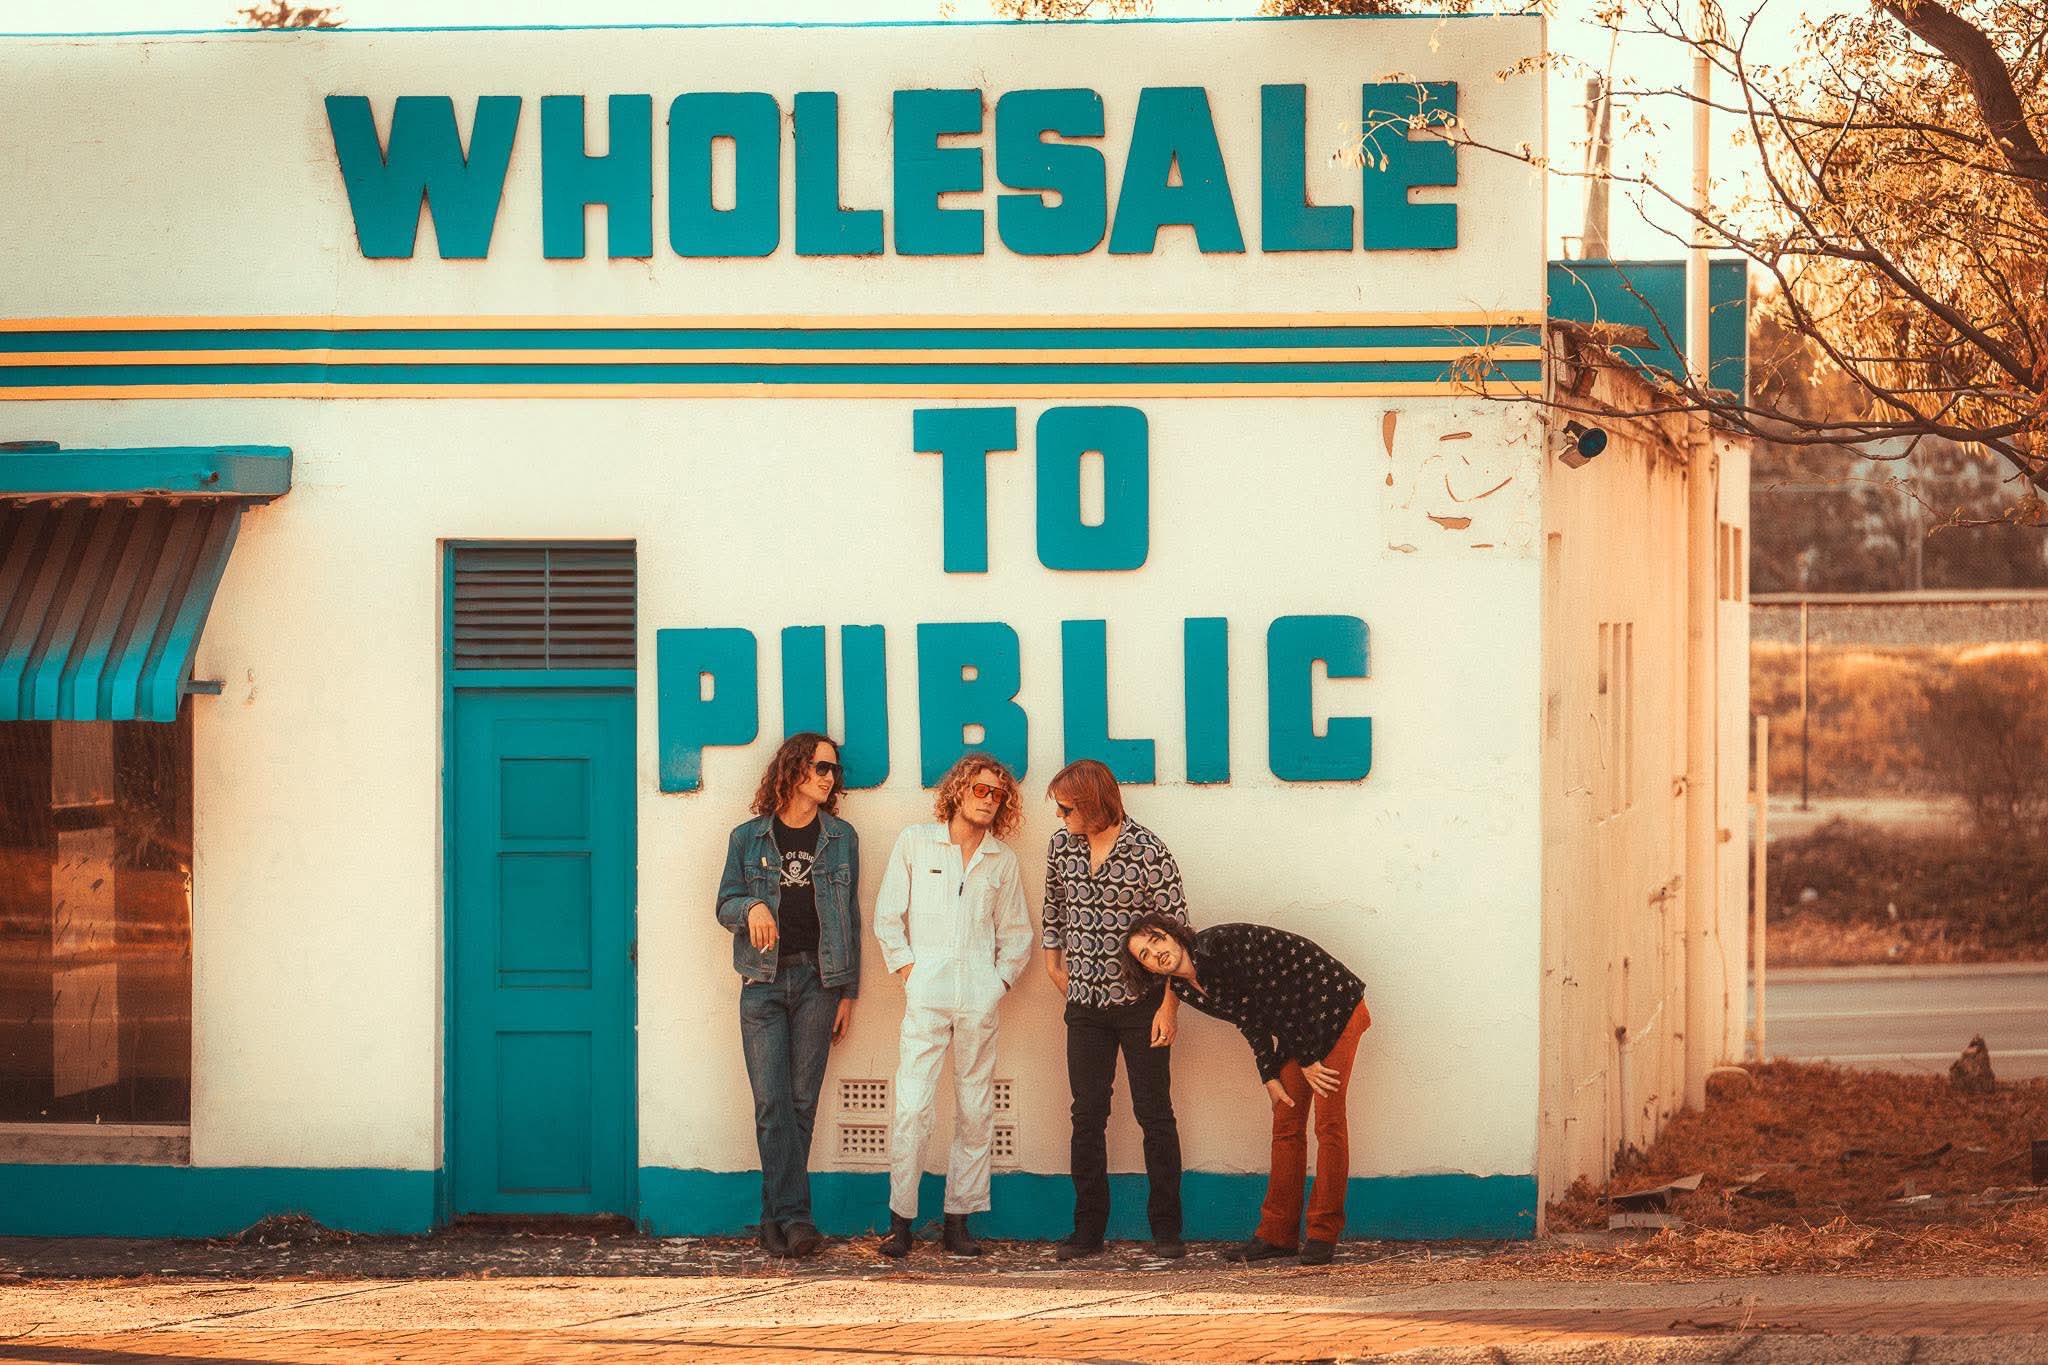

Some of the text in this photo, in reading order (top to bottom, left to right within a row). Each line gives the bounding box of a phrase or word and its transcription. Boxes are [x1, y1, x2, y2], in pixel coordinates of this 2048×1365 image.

[325, 83, 1456, 258] WHOLESALE
[913, 406, 1148, 572] TO
[657, 615, 1373, 792] PUBLIC
